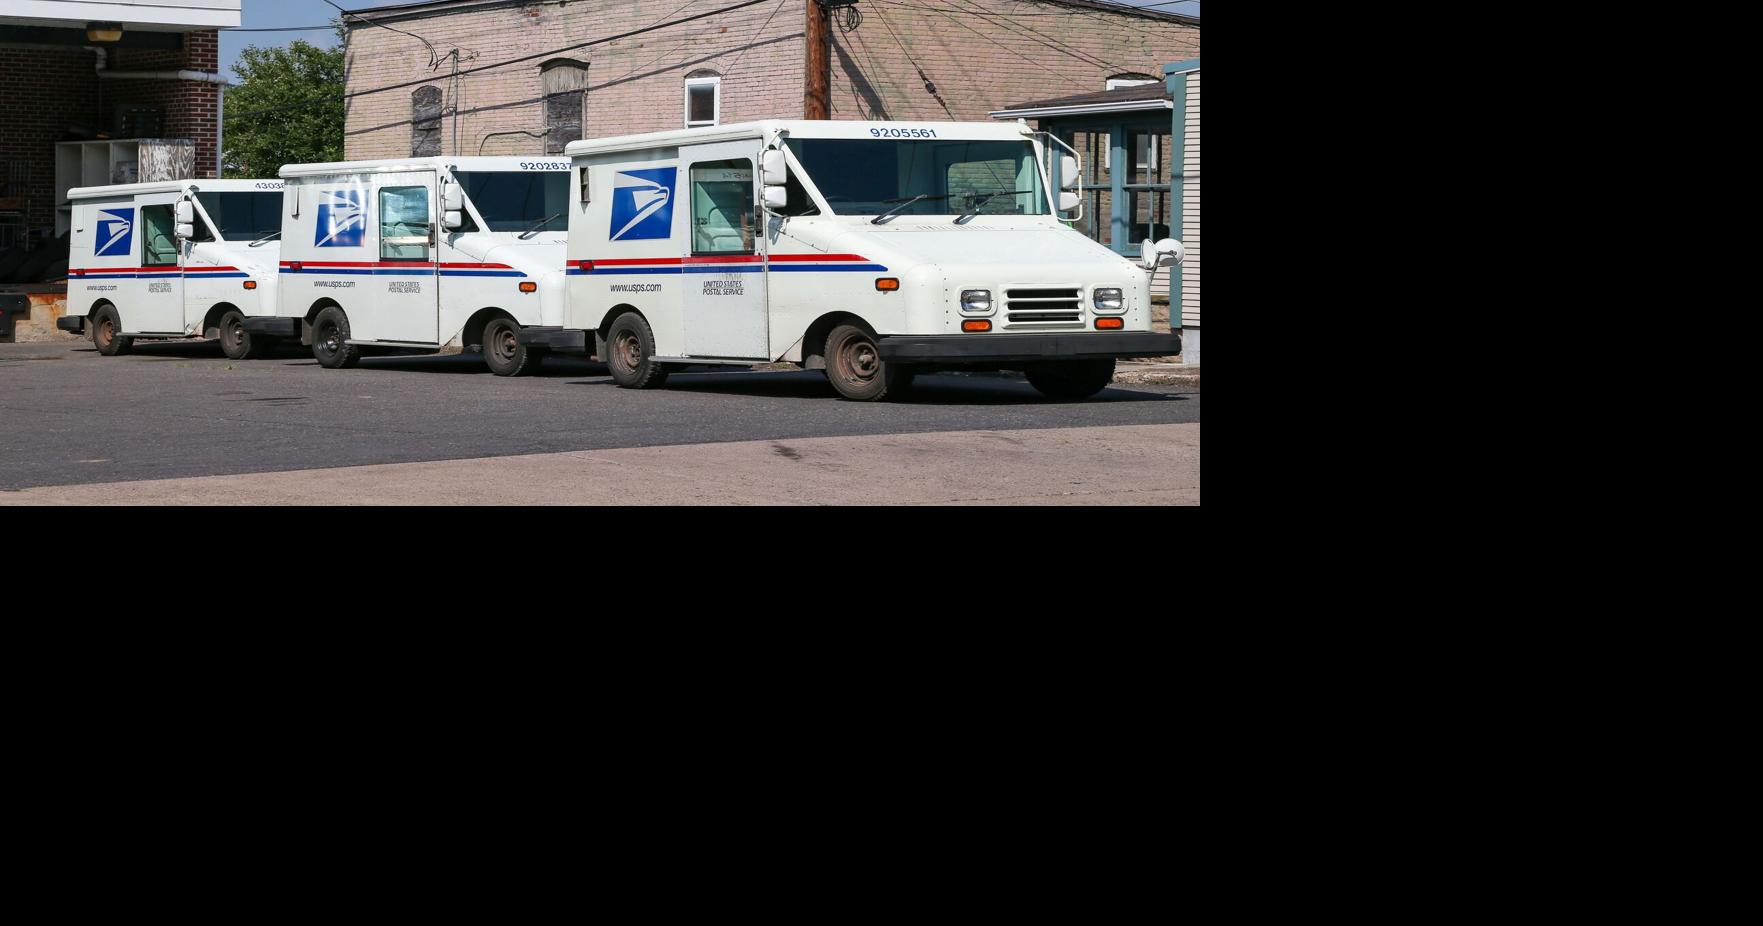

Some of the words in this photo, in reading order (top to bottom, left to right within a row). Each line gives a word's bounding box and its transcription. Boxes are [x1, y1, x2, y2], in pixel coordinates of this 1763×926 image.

[870, 128, 937, 138] 9205561
[520, 162, 571, 170] 9202837
[313, 281, 356, 289] www.usps.com
[610, 283, 662, 293] www.usps.com
[703, 280, 723, 288] UNITED
[724, 280, 742, 288] STATES
[723, 288, 744, 296] SERVICE
